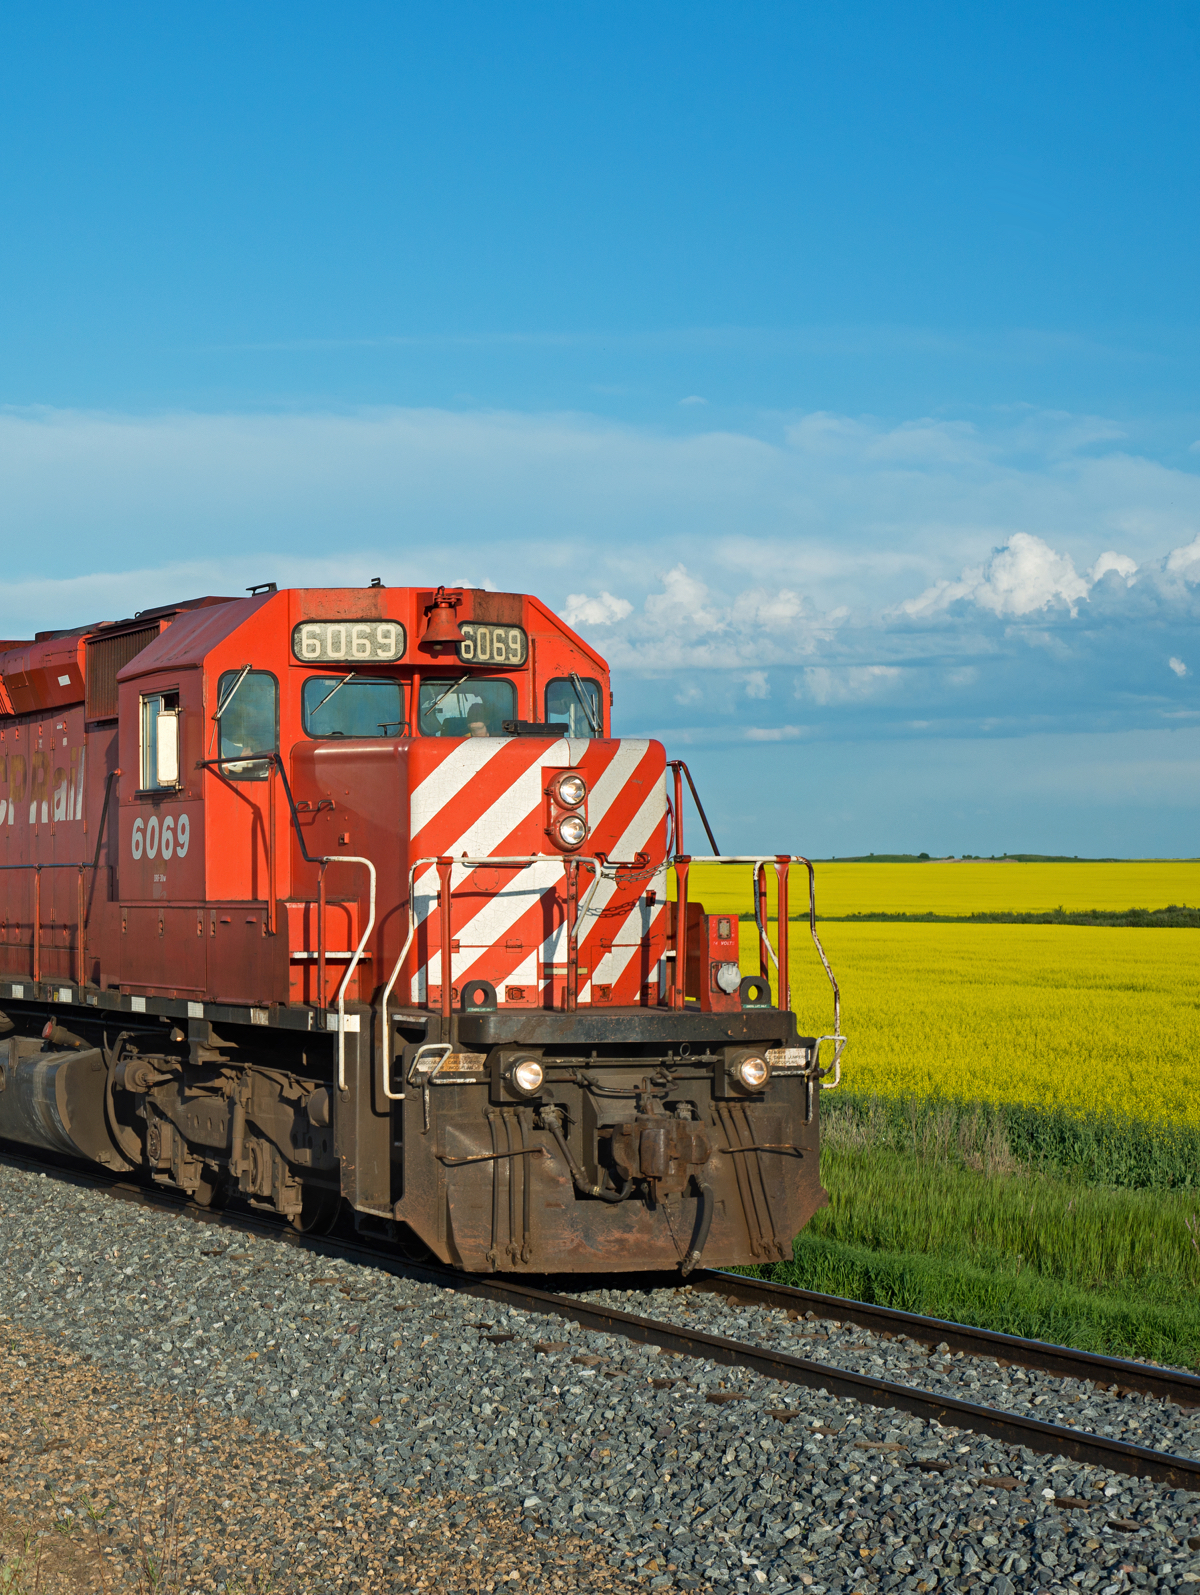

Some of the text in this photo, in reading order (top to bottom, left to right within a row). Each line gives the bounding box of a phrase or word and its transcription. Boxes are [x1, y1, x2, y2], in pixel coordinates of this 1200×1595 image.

[302, 624, 396, 658] 6069
[460, 626, 521, 661] 6069
[131, 813, 190, 860] 6069
